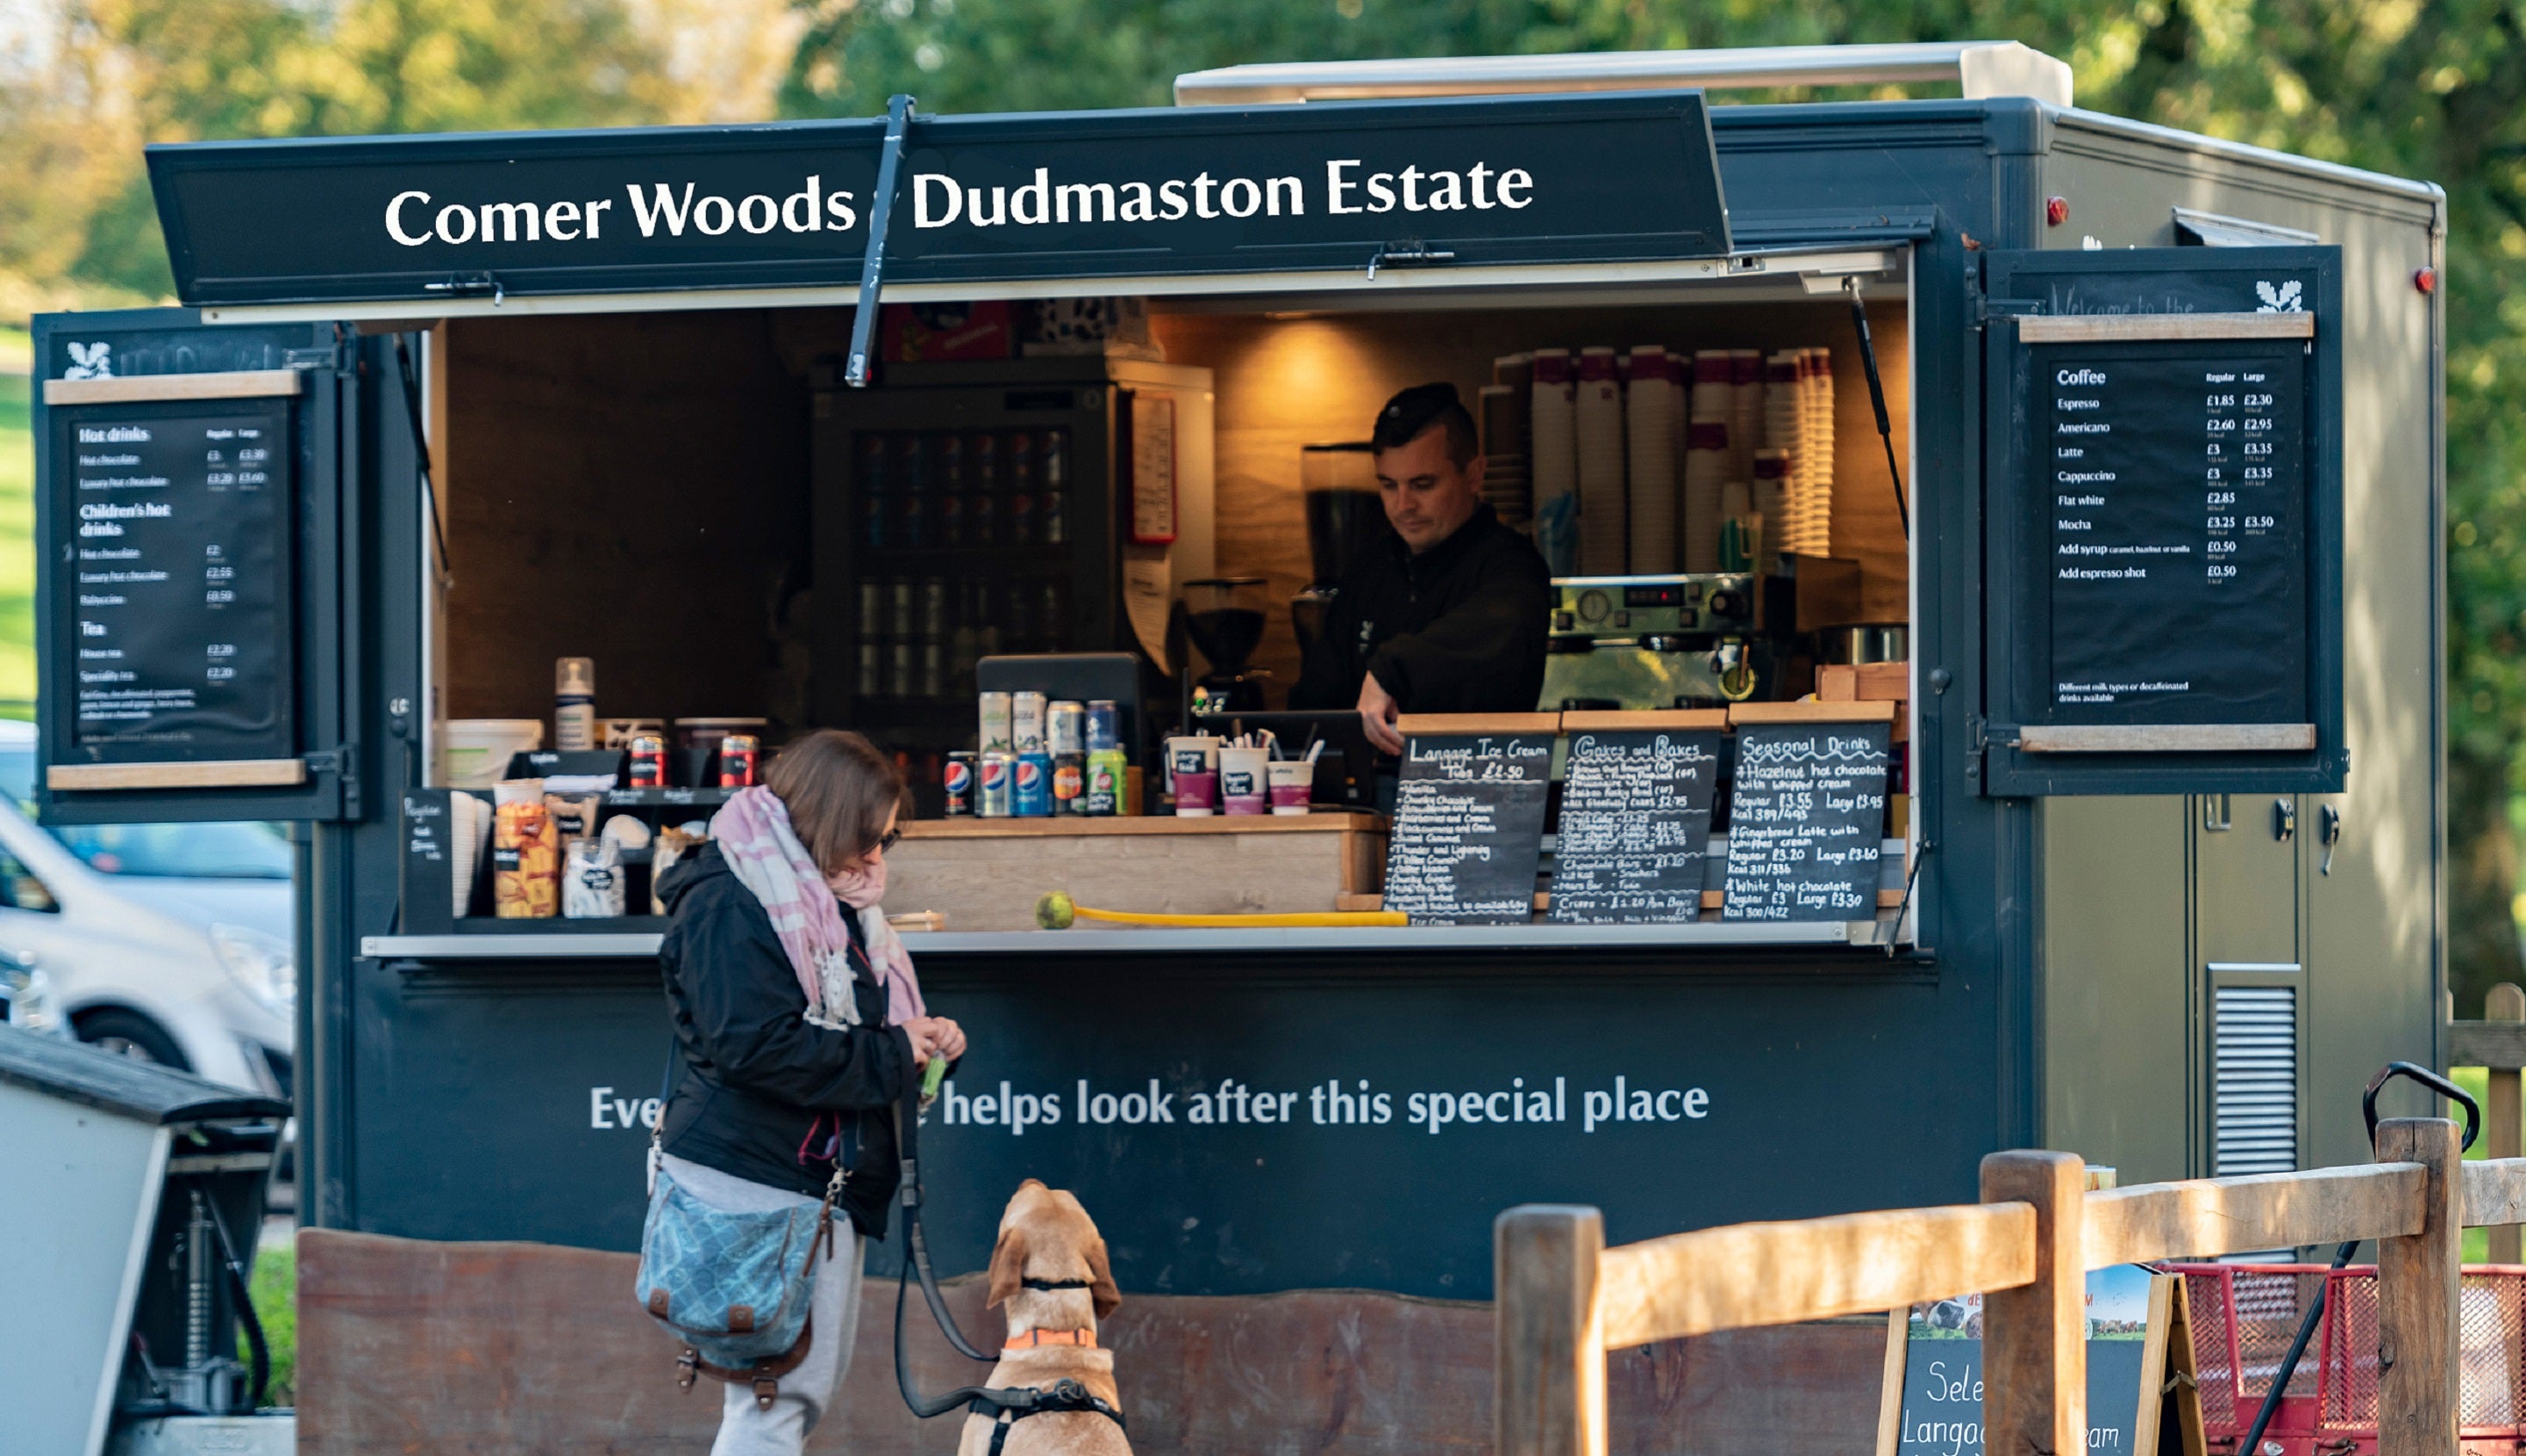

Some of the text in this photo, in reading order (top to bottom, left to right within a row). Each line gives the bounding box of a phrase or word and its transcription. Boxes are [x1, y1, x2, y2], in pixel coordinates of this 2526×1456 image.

[913, 159, 1533, 228] Dudmaston Estate
[385, 175, 855, 246] Comer Woods
[2057, 369, 2106, 386] Coffee
[2206, 372, 2266, 384] Regular Large
[2058, 398, 2101, 410] Espresso
[2207, 394, 2273, 407] £1.85 £2.30
[2058, 421, 2110, 432] Americano
[2207, 418, 2273, 431] £2.60 £2.95
[79, 426, 152, 443] Hot drinks
[2058, 447, 2084, 458] Latte
[2207, 442, 2273, 455] £3 £3.35
[2058, 471, 2116, 484] Cappuccino
[2207, 467, 2273, 479] £3 £3.35
[2059, 495, 2105, 506] Flat white
[2207, 492, 2236, 503] £2.85
[146, 502, 173, 517] hot
[2059, 519, 2092, 531] Mocha
[2207, 516, 2274, 528] £3.25 £3.50
[80, 522, 125, 538] drinks
[2059, 544, 2079, 555] Add
[2080, 545, 2108, 557] syrup
[2208, 540, 2237, 553] £0.50
[2059, 567, 2146, 581] Add espresso shot
[2208, 565, 2237, 577] £0.50
[80, 621, 107, 637] Tea
[2059, 682, 2091, 692] Different
[2091, 682, 2108, 691] milk
[2109, 683, 2129, 693] types
[2139, 682, 2189, 691] decaffeinated
[2059, 693, 2115, 703] drinks available
[1475, 738, 1502, 760] Ice
[1507, 739, 1548, 760] Cream
[1743, 736, 1871, 756] Seasonal Drinks
[1811, 762, 1832, 777] hot
[1834, 763, 1887, 777] chocolate
[1738, 778, 1766, 790] with
[1816, 780, 1852, 790] cream
[1733, 791, 1883, 813] Regular £3.55 Large £3.95
[1830, 824, 1859, 837] with
[1780, 838, 1812, 847] cream
[1772, 847, 1805, 862] £3.20
[1816, 846, 1846, 866] Large
[1735, 879, 1852, 893] White hot chocolate
[1728, 891, 1863, 910] Regular £3 Large £3.30
[590, 1075, 1710, 1136] Eve helps look after this special place
